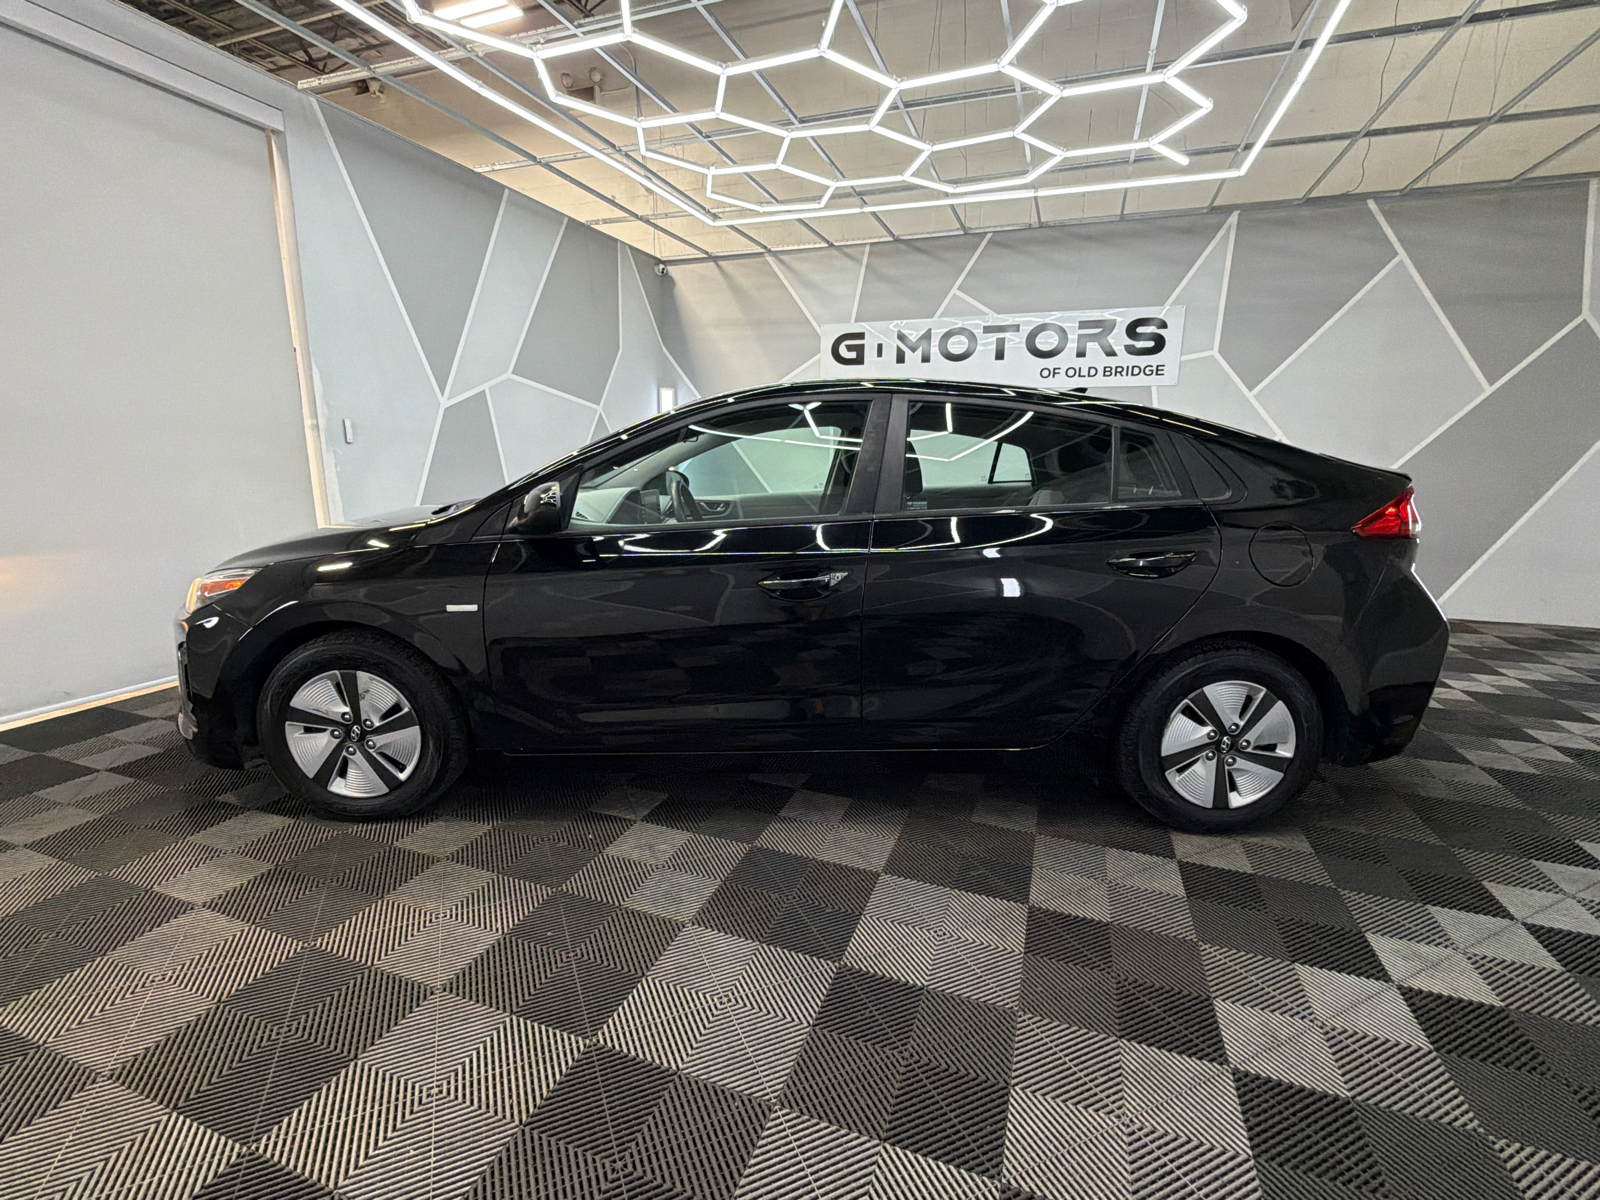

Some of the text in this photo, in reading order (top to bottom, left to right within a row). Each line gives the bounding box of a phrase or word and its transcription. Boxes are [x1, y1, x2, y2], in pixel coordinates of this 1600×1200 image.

[1040, 364, 1165, 379] OF OLD BRIDGE
